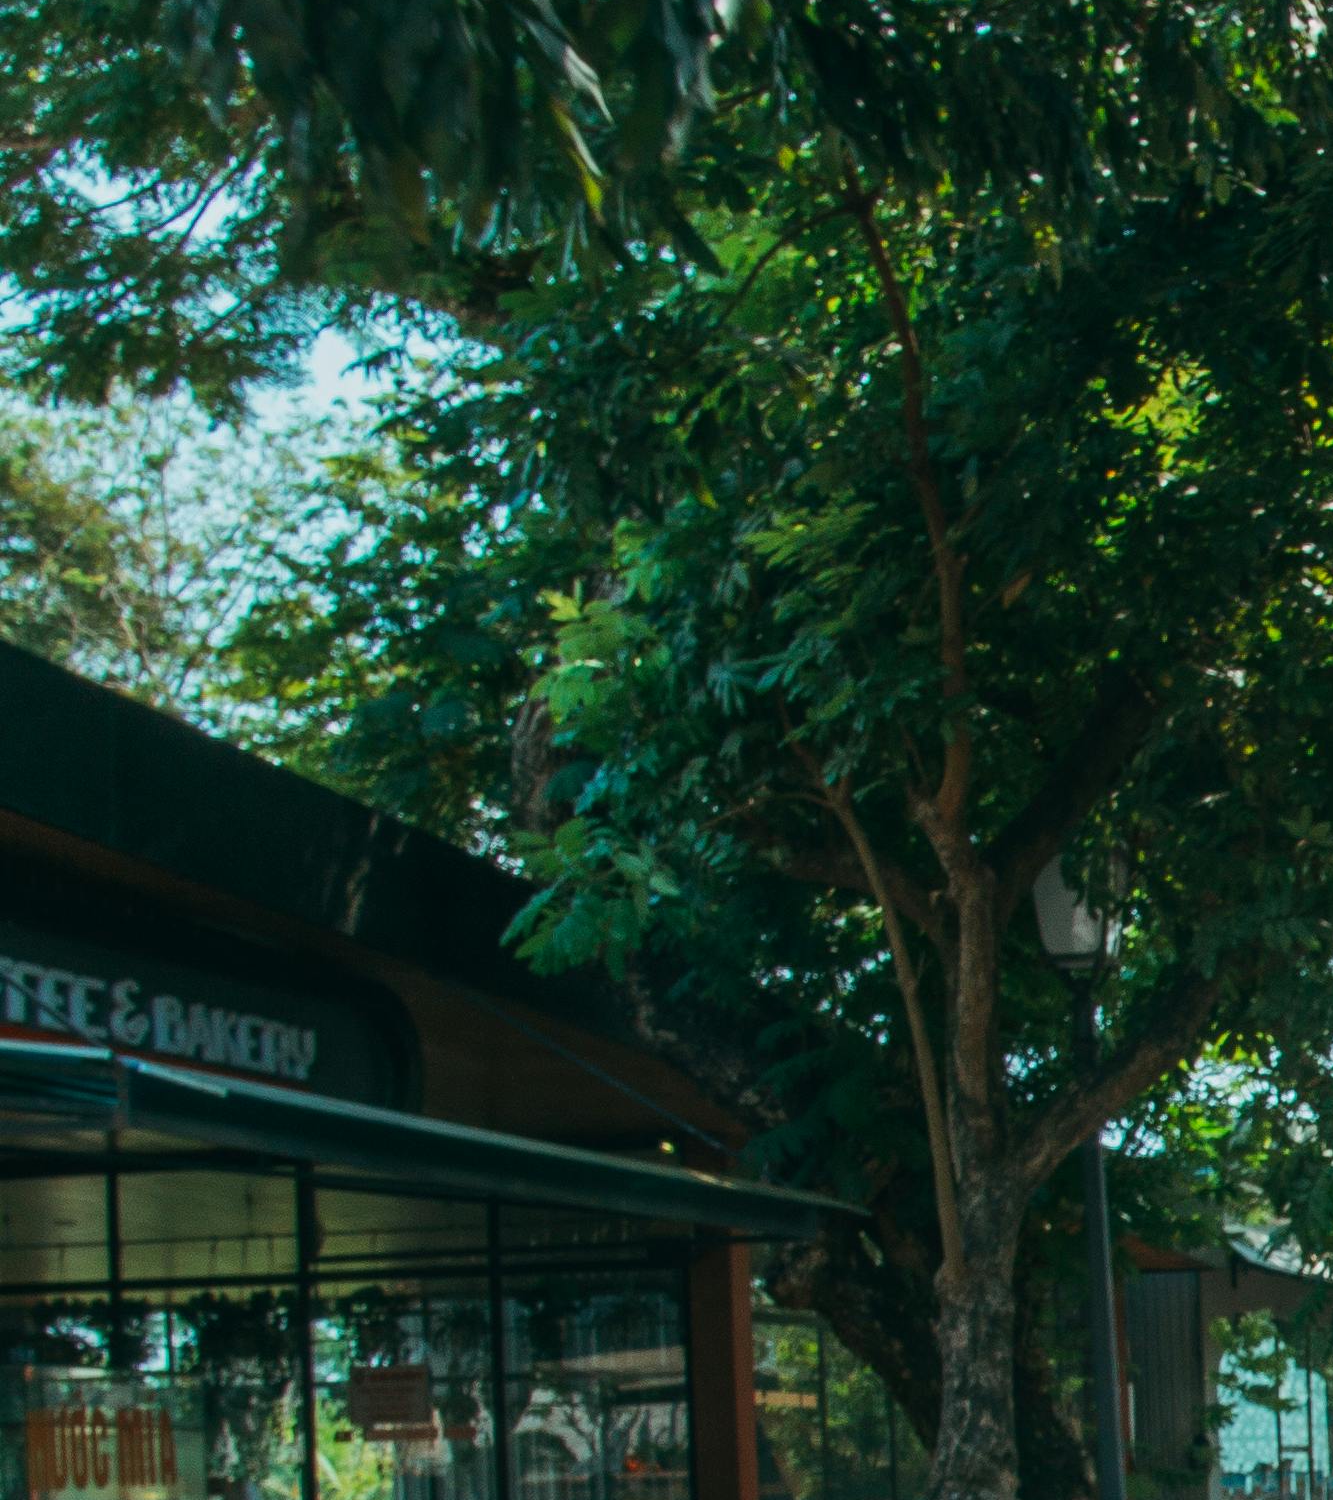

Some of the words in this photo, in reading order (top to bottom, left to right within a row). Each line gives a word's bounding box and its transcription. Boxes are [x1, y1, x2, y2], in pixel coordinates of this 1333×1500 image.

[0, 957, 107, 1041] FEE
[111, 979, 149, 1045] &
[153, 995, 317, 1080] BAKERY
